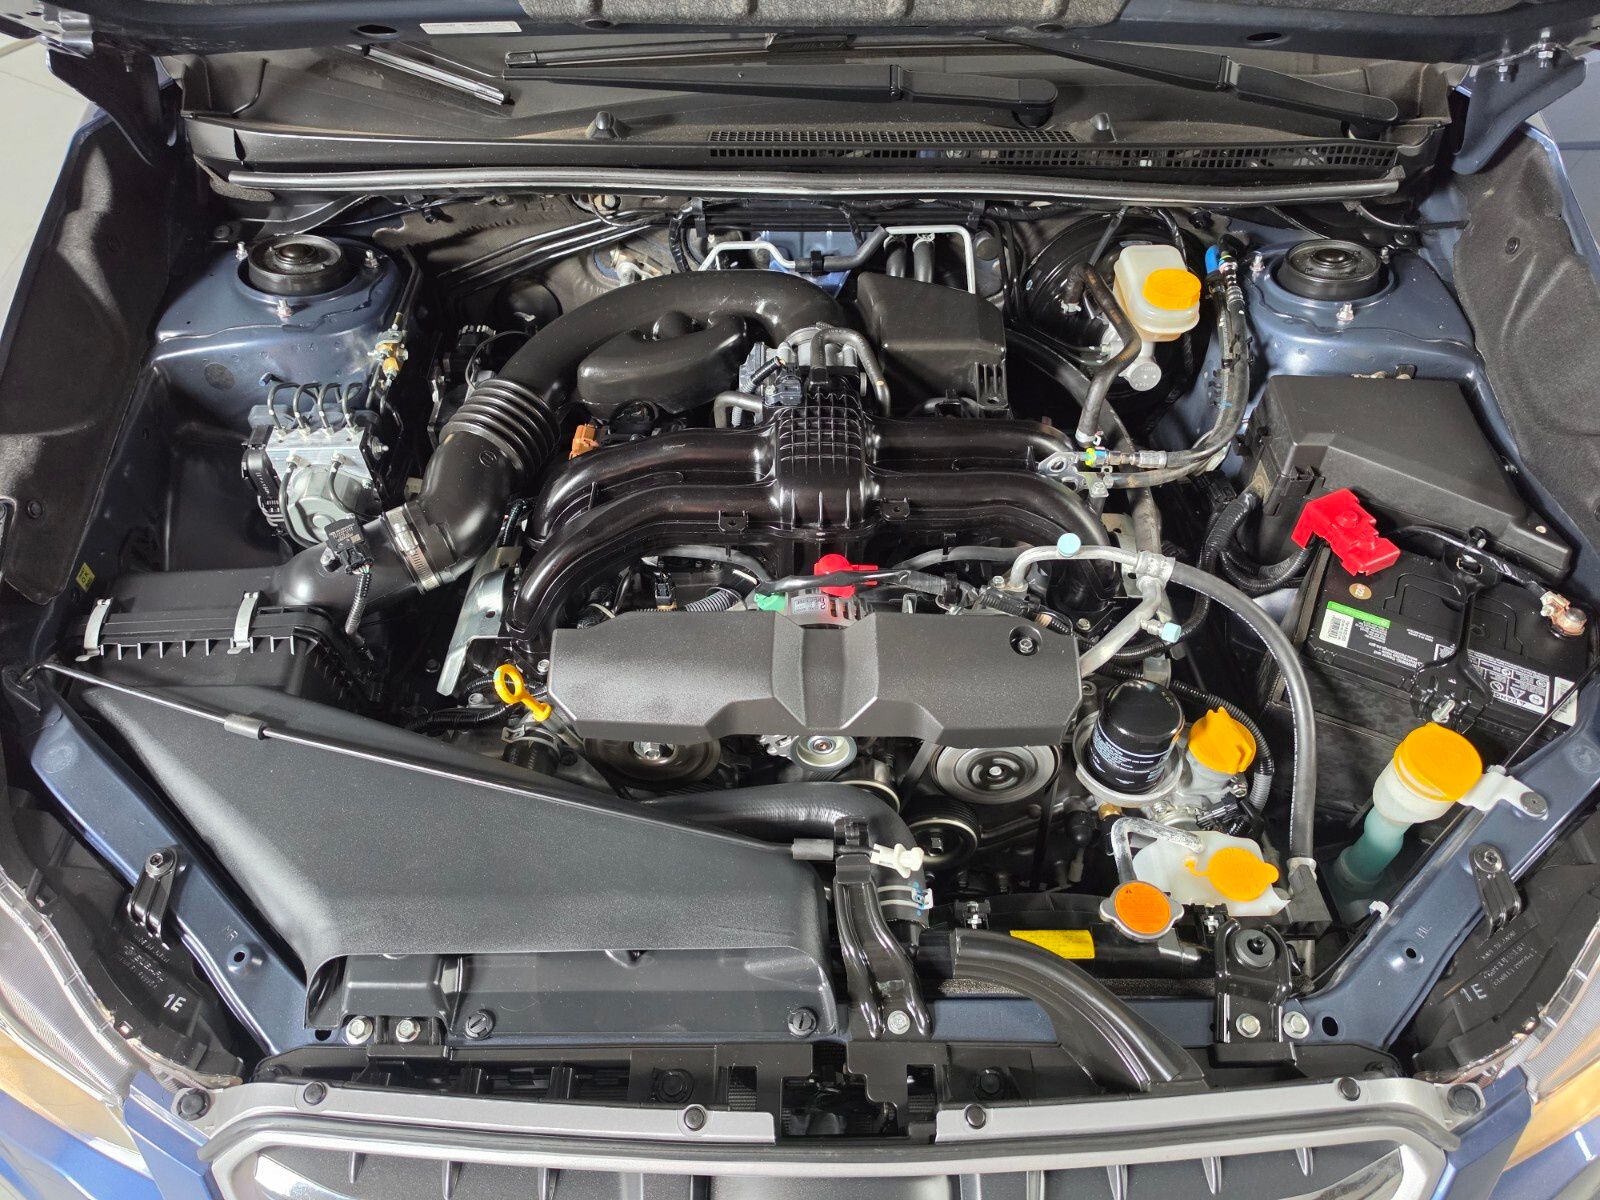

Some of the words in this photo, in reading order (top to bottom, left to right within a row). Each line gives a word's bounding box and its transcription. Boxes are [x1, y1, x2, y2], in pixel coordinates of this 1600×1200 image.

[1493, 692, 1519, 705] DANG
[1460, 983, 1487, 1002] 1E
[163, 993, 187, 1013] 1E
